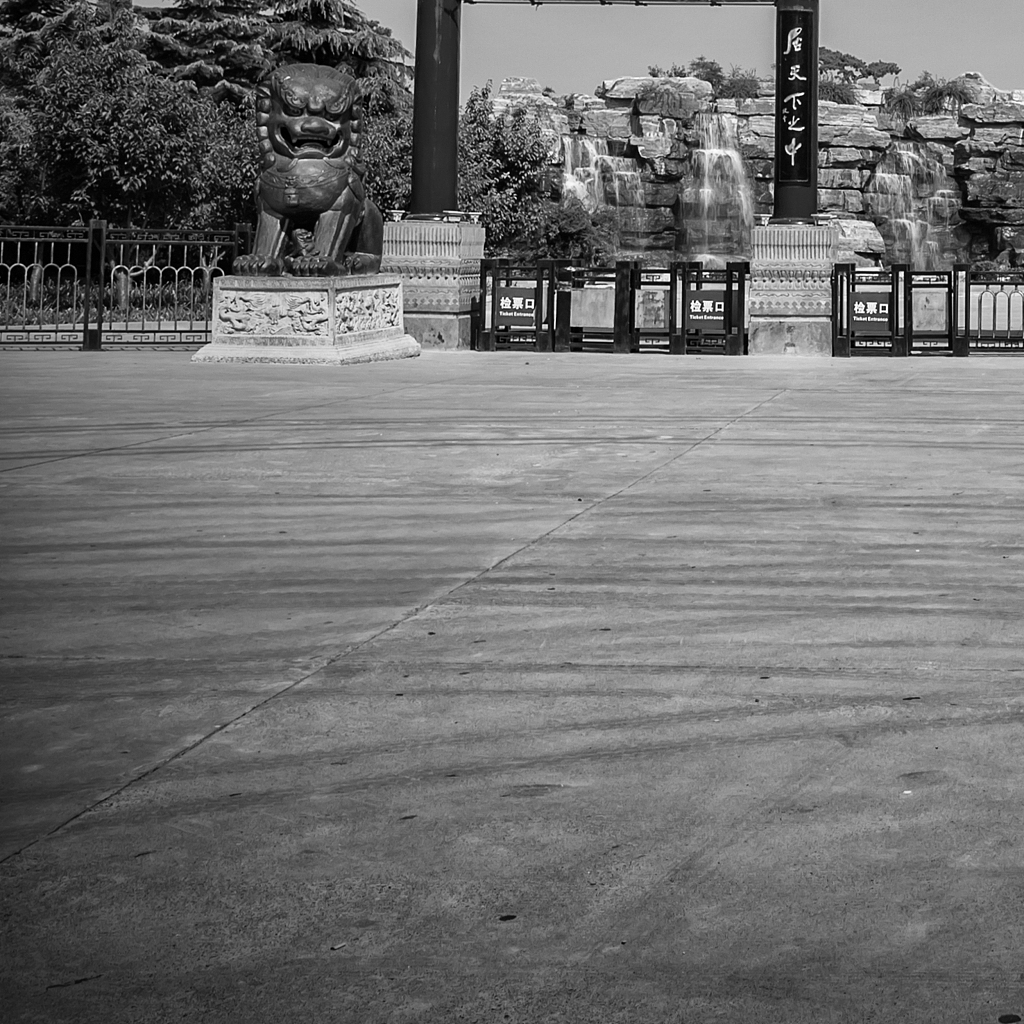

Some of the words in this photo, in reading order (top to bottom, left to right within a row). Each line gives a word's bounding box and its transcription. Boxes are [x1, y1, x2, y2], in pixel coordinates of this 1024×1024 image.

[500, 297, 535, 309] 检票口
[690, 300, 724, 312] 检票口
[854, 302, 889, 314] 检票口
